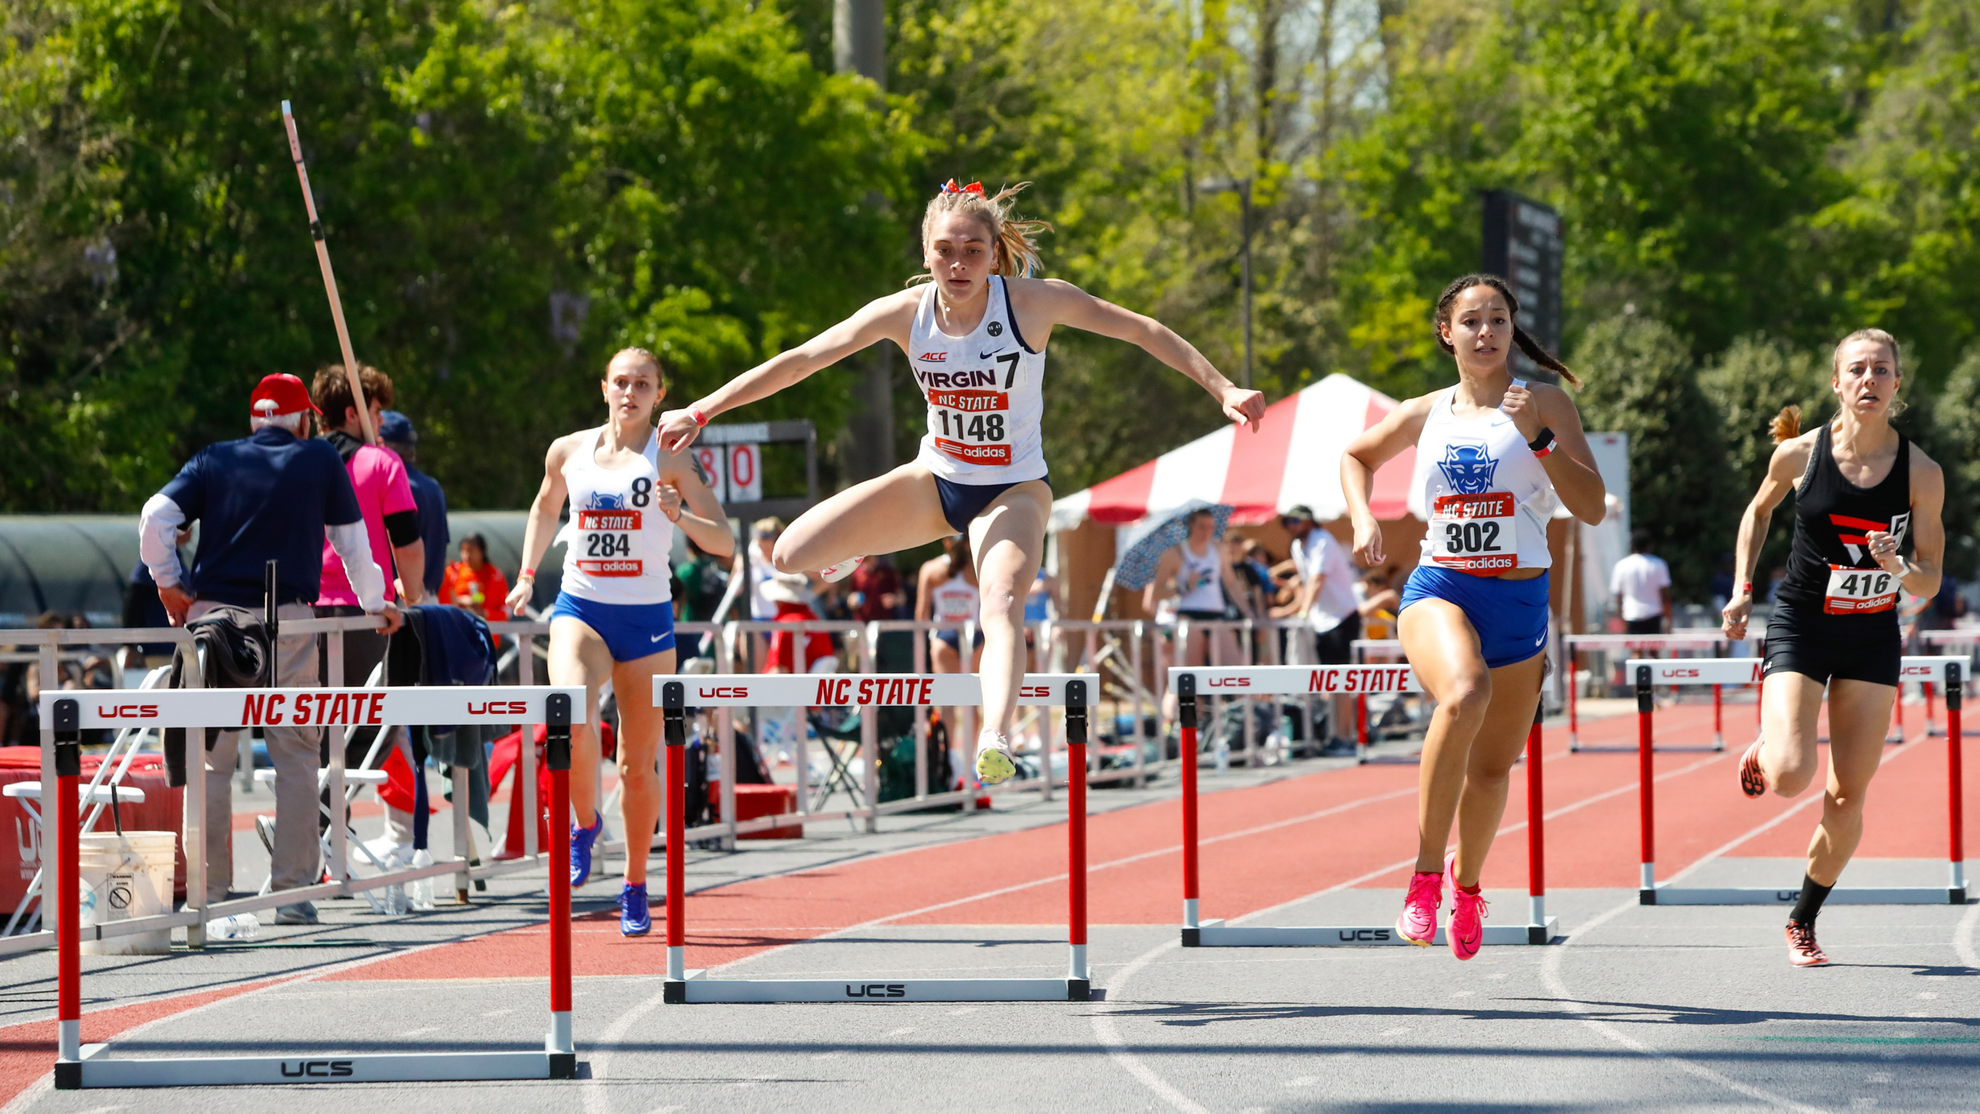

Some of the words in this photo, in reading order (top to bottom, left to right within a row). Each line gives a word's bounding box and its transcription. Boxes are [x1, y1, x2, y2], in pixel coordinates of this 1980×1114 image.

[920, 352, 948, 361] ACC
[914, 366, 995, 387] VIRGIN
[996, 351, 1020, 390] 7
[938, 394, 956, 407] NC
[958, 396, 998, 411] STATE
[938, 410, 1003, 441] 1148
[964, 447, 1006, 458] adidas
[632, 477, 651, 507] 8
[1443, 502, 1460, 518] NC
[1462, 500, 1505, 518] STATE
[584, 516, 599, 529] NC
[600, 516, 634, 529] STATE
[1446, 521, 1502, 554] 302
[587, 533, 630, 557] 284
[602, 561, 639, 572] adidas
[1467, 557, 1512, 570] adidas
[1840, 573, 1892, 597] 416
[1856, 596, 1892, 609] adidas
[1662, 668, 1699, 678] UCS
[1209, 677, 1251, 688] UCS
[1309, 670, 1338, 692] NC
[1344, 669, 1411, 692] STATE
[699, 687, 749, 699] UCS
[816, 679, 852, 705] NC
[857, 679, 935, 705] STATE
[1019, 686, 1050, 698] CS
[98, 704, 159, 718] UCS
[242, 693, 286, 725] NC
[292, 693, 387, 725] STATE
[467, 701, 527, 715] UCS
[1339, 929, 1390, 942] UCS
[845, 984, 906, 998] UCS
[281, 1061, 354, 1078] UCS
